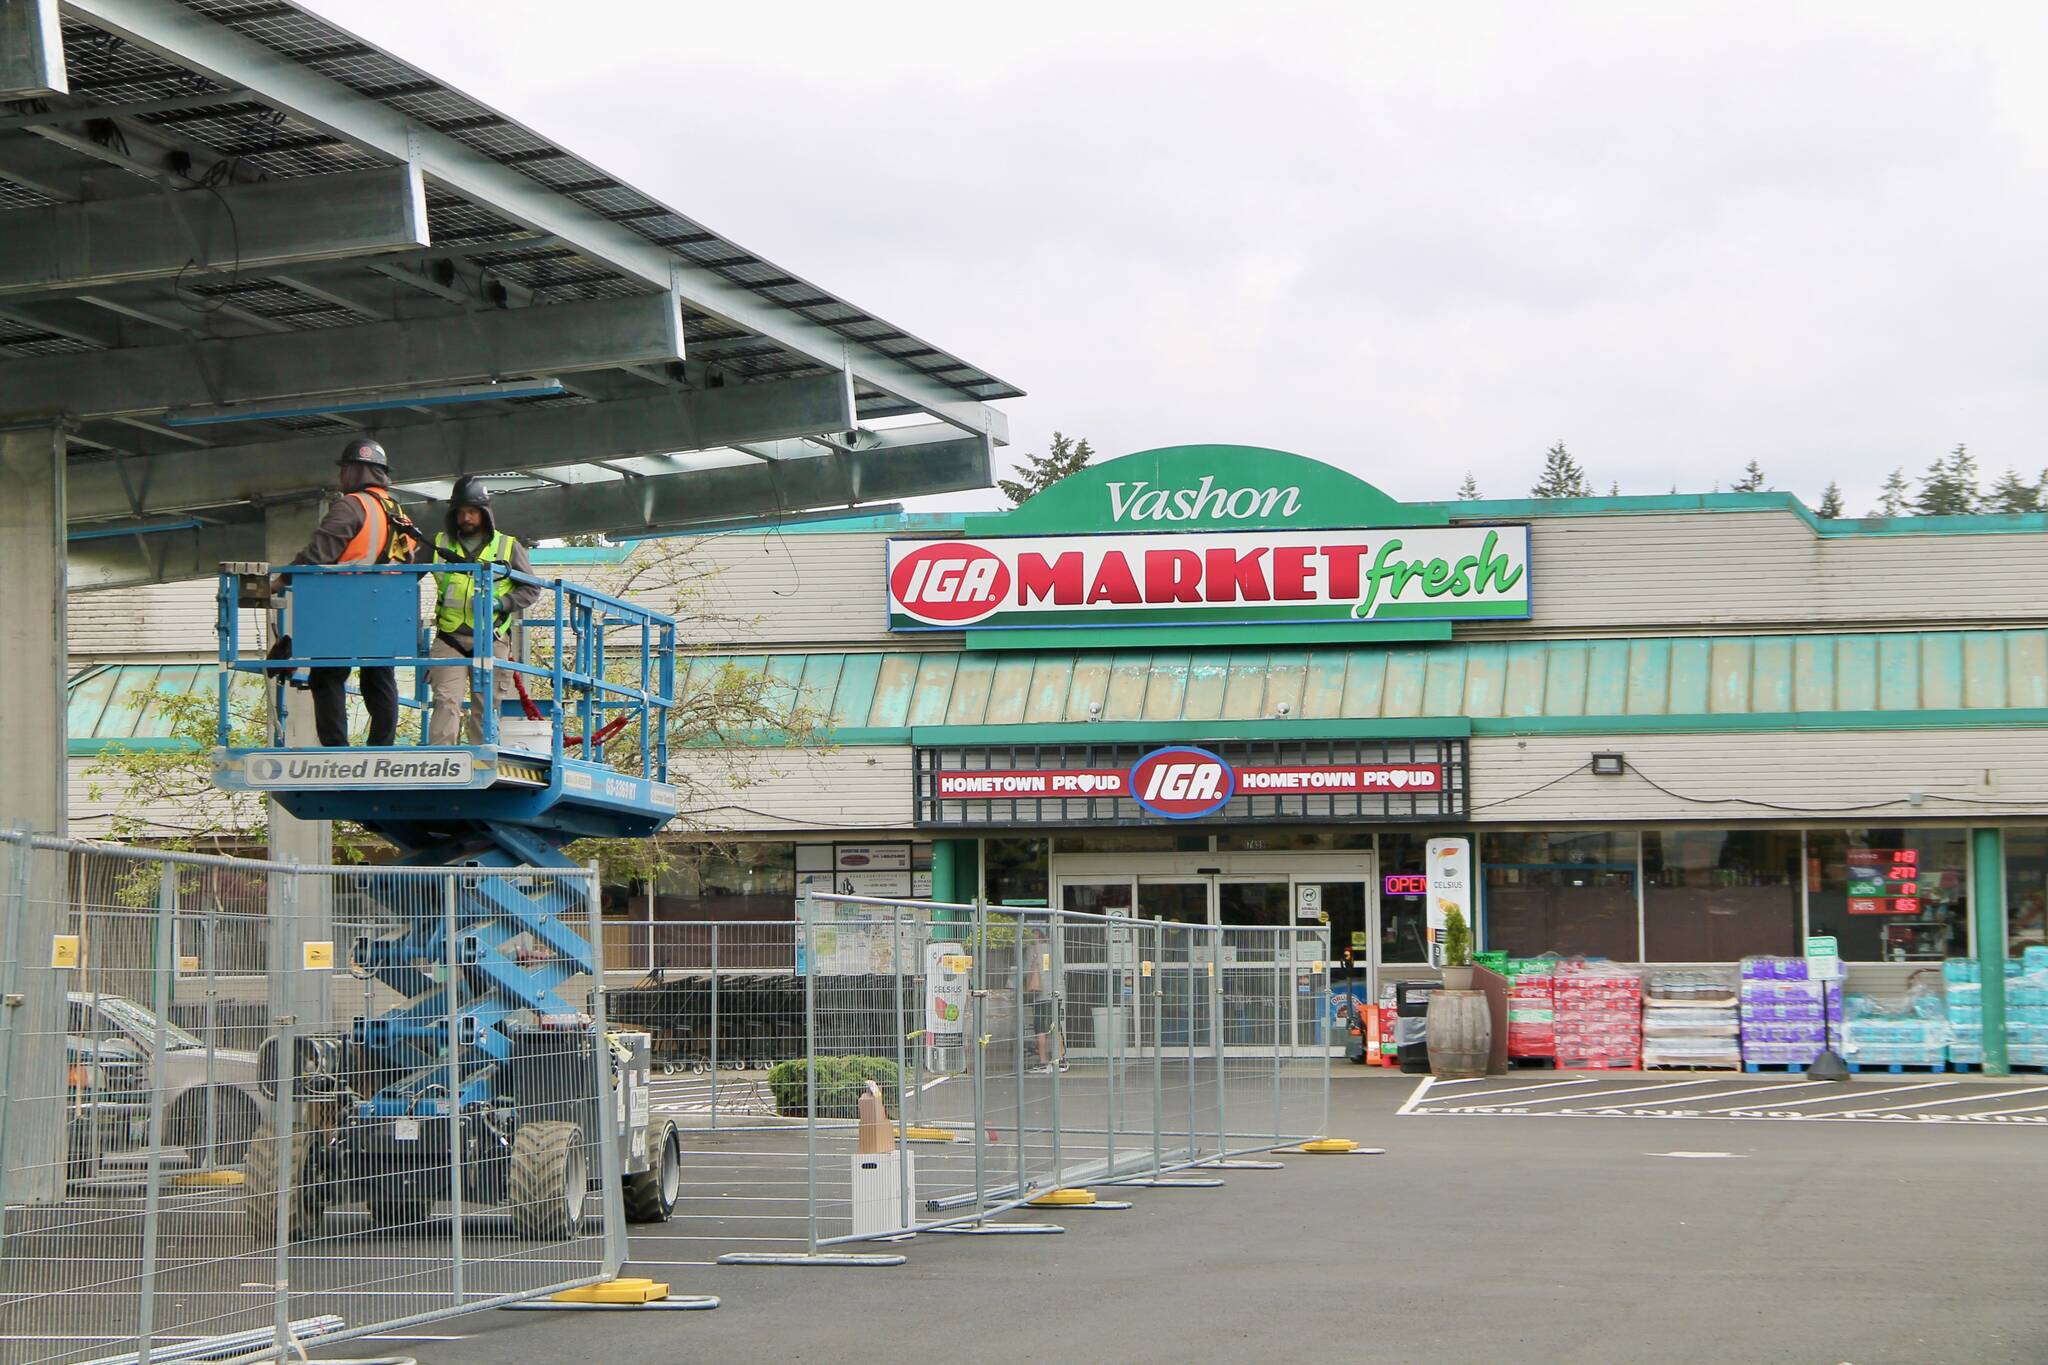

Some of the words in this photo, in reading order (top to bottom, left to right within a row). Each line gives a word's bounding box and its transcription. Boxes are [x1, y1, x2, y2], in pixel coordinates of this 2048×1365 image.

[1105, 474, 1302, 523] Vashon
[902, 557, 1000, 603] IGA
[1017, 544, 1369, 606] MARKET
[1355, 529, 1524, 619] fresh
[288, 758, 369, 779] United
[373, 757, 461, 778] Rentals
[941, 775, 1046, 793] HOMETOWN
[1143, 763, 1223, 801] IGA
[1242, 771, 1356, 788] HOMETOWN
[1433, 881, 1464, 889] CELSIUS
